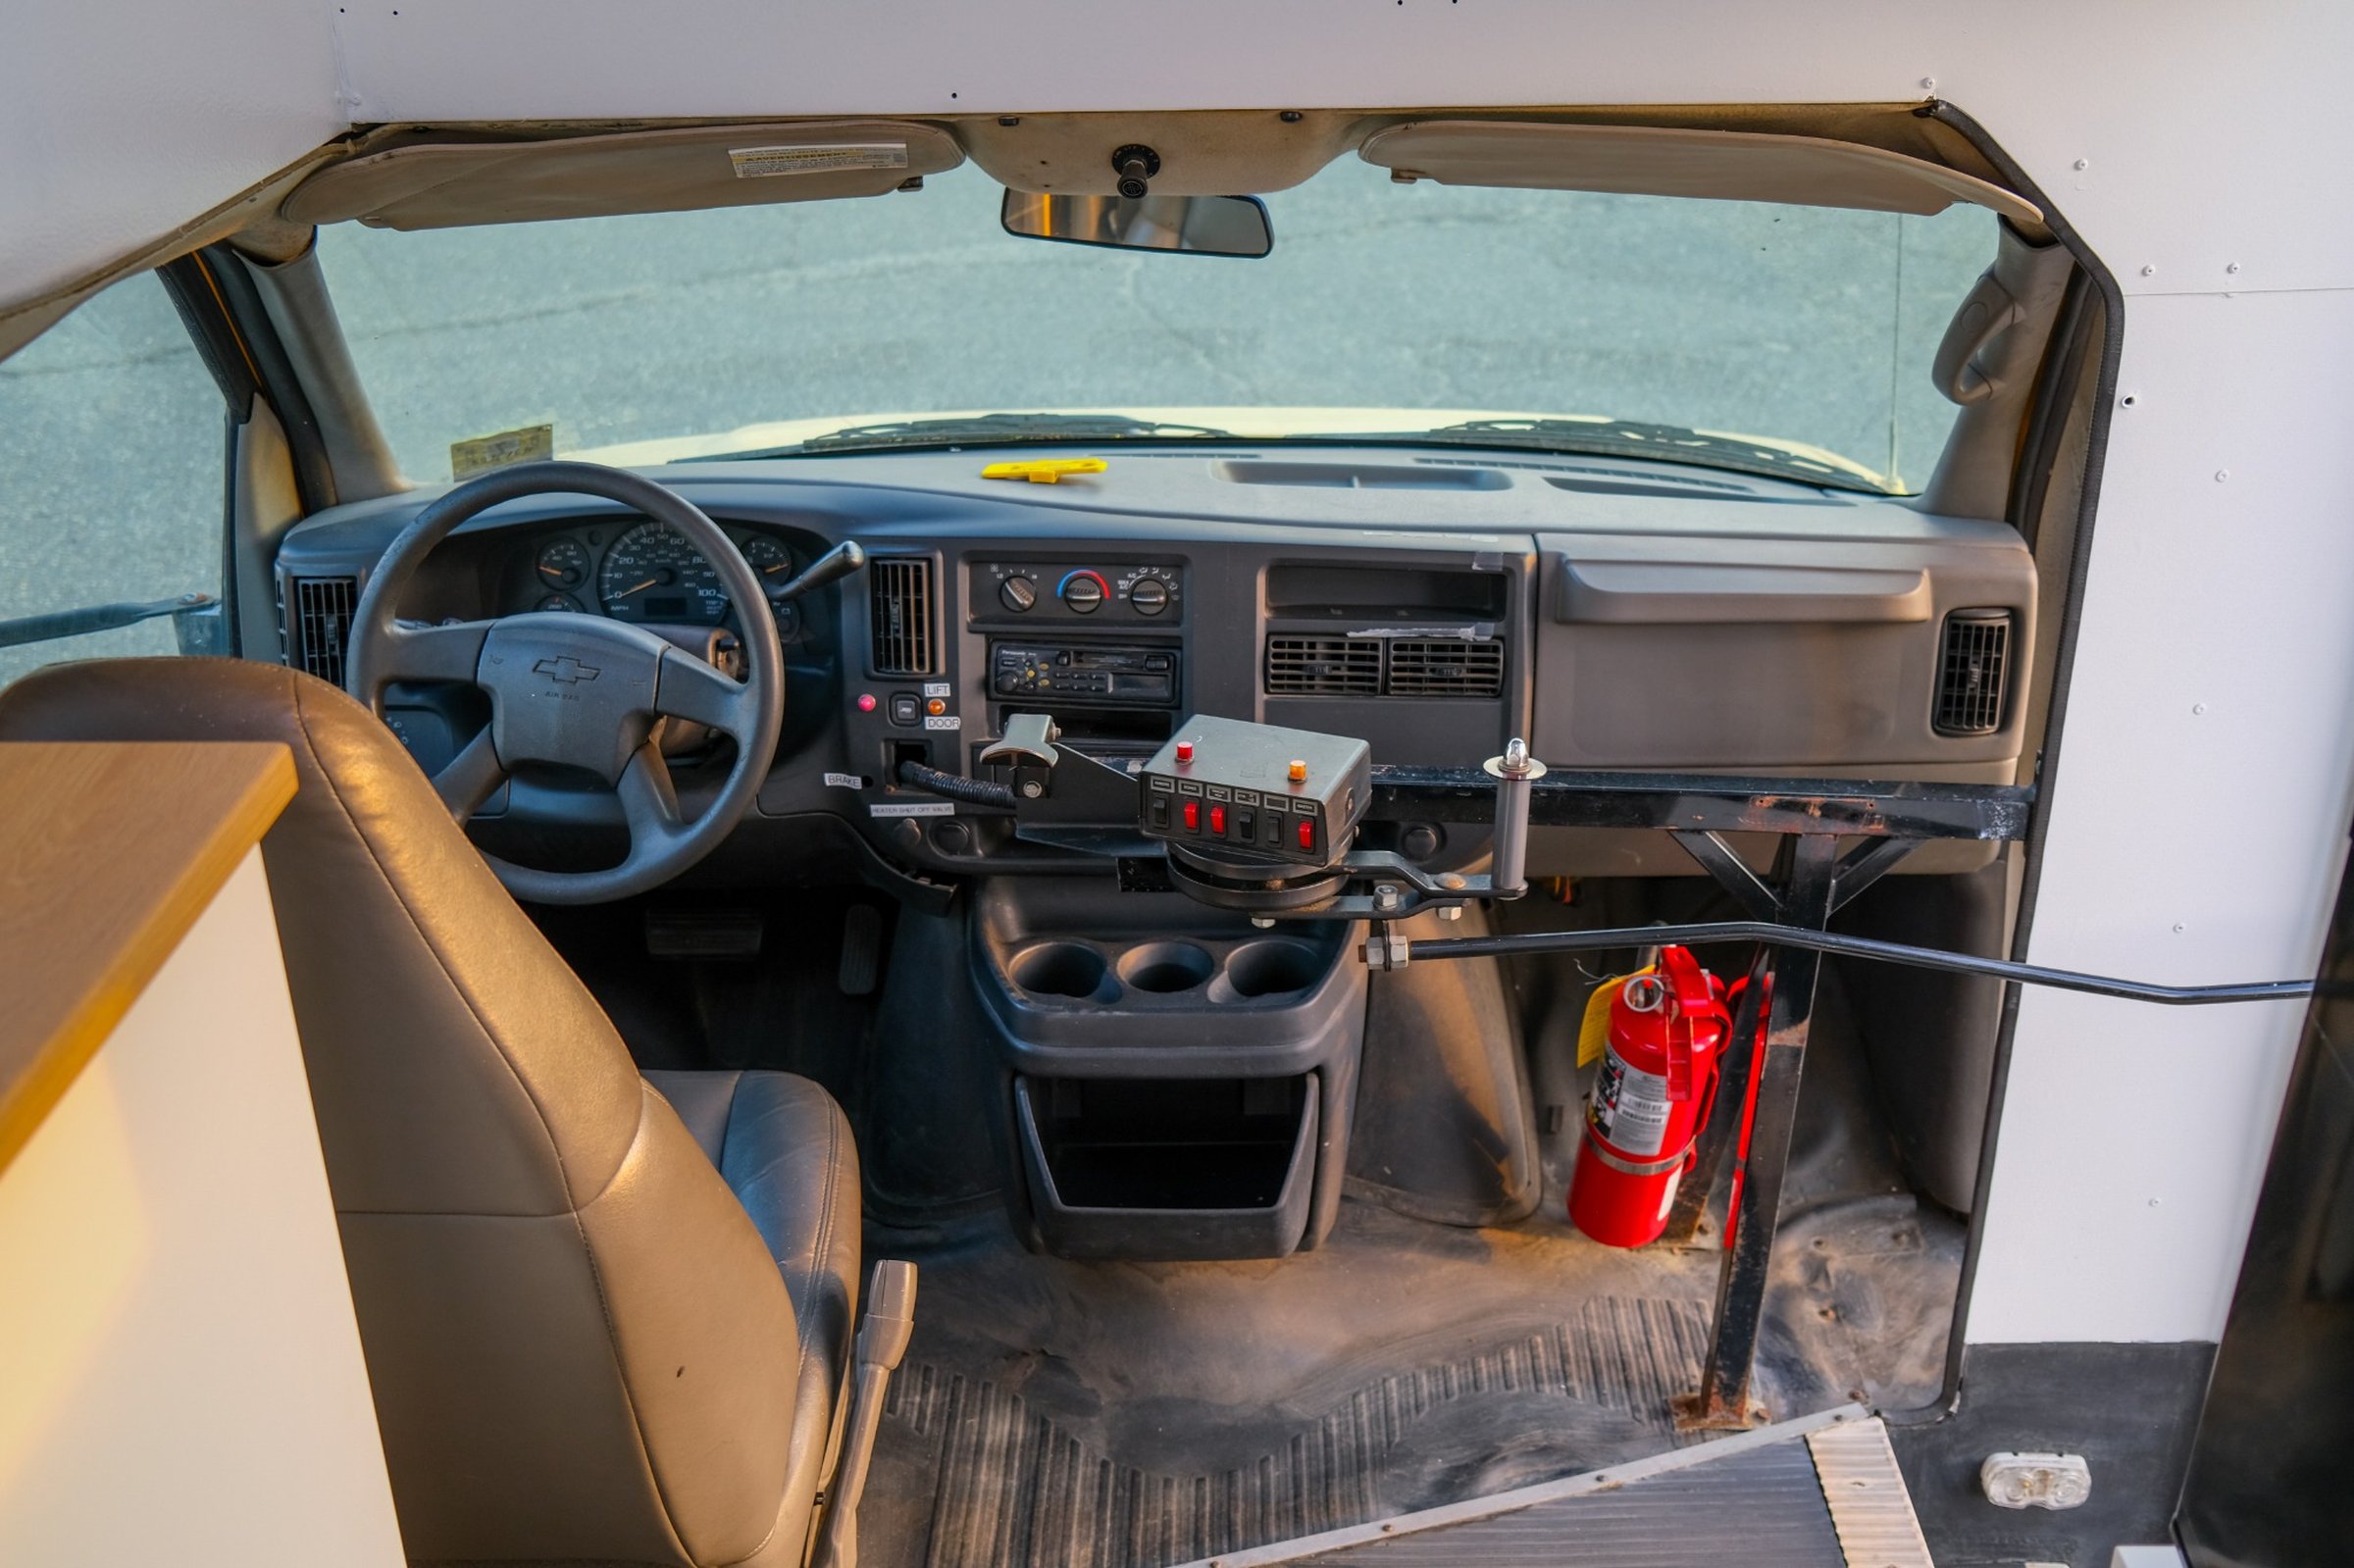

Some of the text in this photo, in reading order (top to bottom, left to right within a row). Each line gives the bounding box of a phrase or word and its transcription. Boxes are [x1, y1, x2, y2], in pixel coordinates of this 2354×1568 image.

[670, 536, 685, 545] 60
[697, 588, 717, 597] 100
[926, 684, 949, 695] LIFT
[928, 718, 960, 729] DOOR
[827, 774, 861, 787] BRAKE
